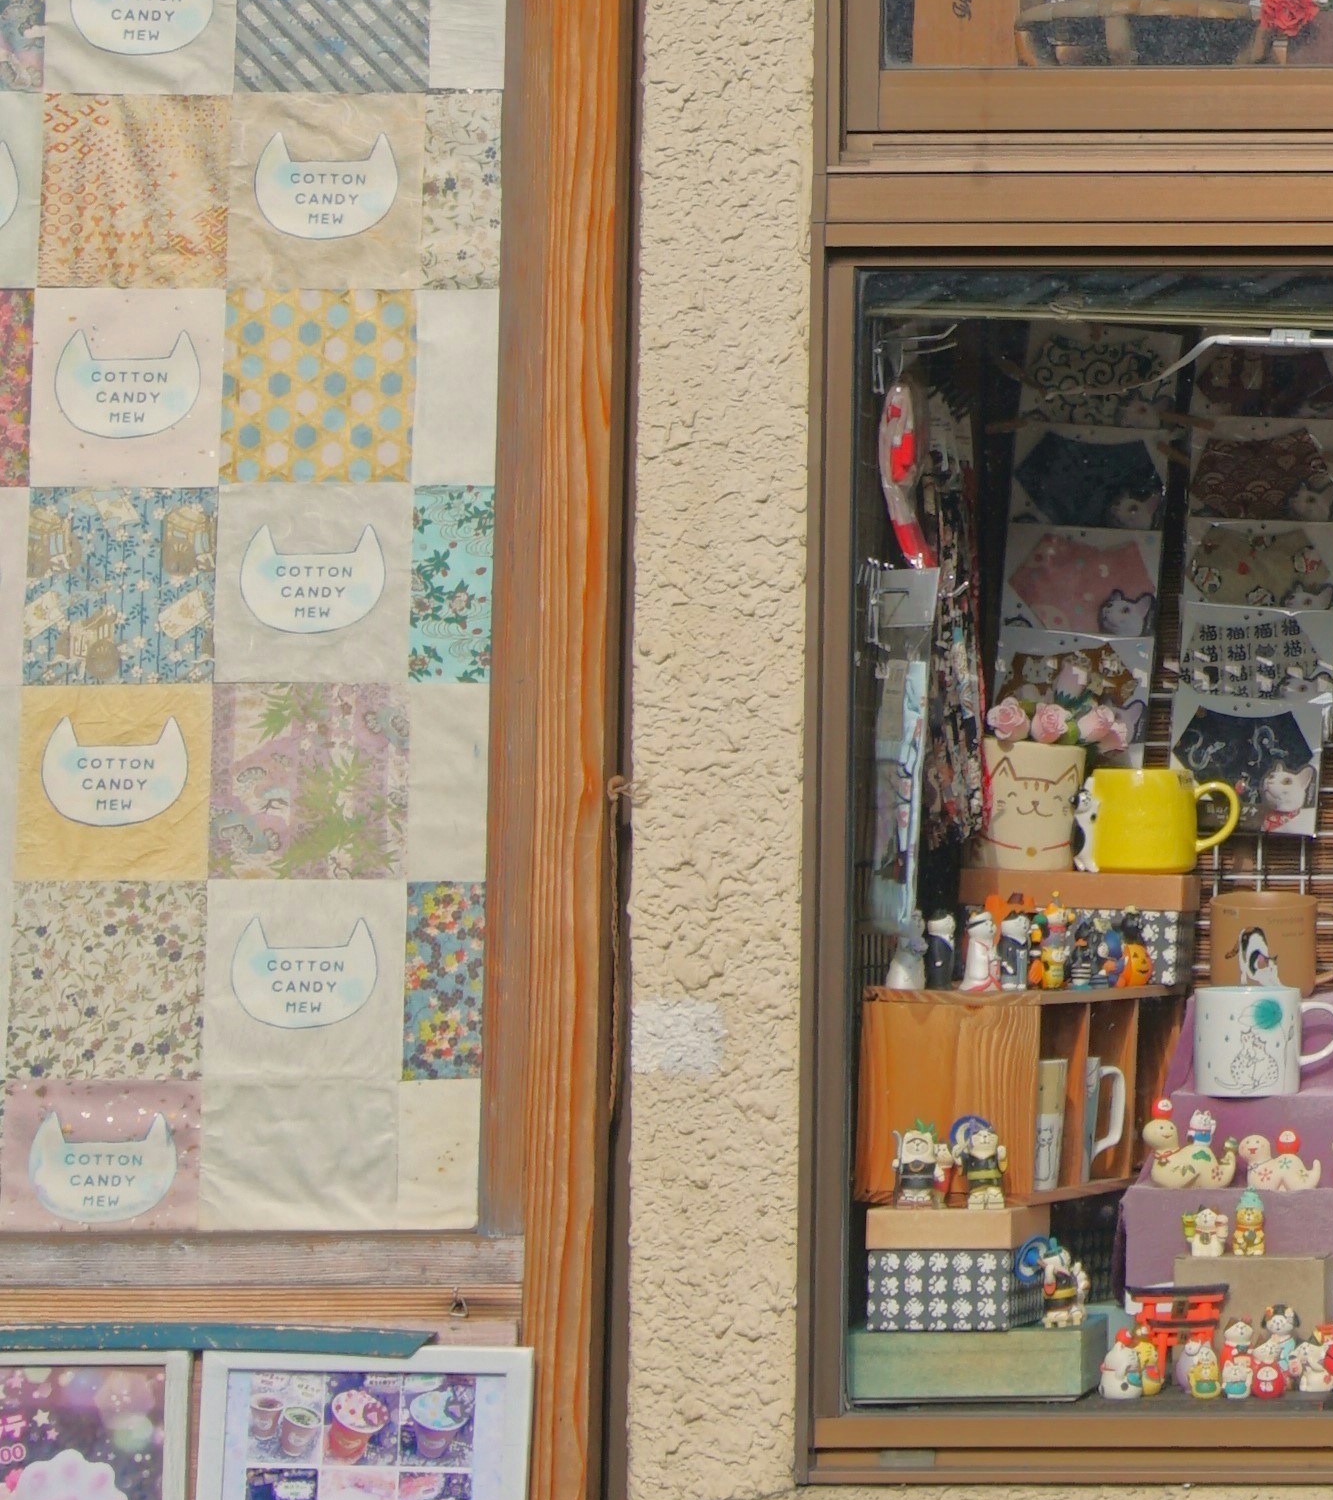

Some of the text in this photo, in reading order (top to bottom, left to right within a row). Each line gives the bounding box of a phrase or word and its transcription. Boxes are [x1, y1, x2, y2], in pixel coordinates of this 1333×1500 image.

[111, 8, 175, 22] CANDY
[123, 29, 160, 41] MEW
[290, 171, 366, 185] COTTON
[295, 192, 359, 206] CANDY
[308, 213, 344, 225] MEW
[91, 370, 168, 384] COTTON
[95, 391, 161, 404] CANDY
[109, 411, 146, 423] MEW
[275, 564, 353, 578] COTTON
[280, 585, 346, 599] CANDY
[294, 606, 331, 618] MEW
[77, 757, 155, 771] COTTON
[81, 778, 148, 791] CANDY
[95, 798, 133, 811] MEW
[267, 959, 345, 973] COTTON
[271, 980, 338, 994] CANDY
[285, 1001, 322, 1013] MEW
[64, 1153, 143, 1167] COTTON
[69, 1174, 136, 1187] CANDY
[82, 1195, 120, 1207] MEW
